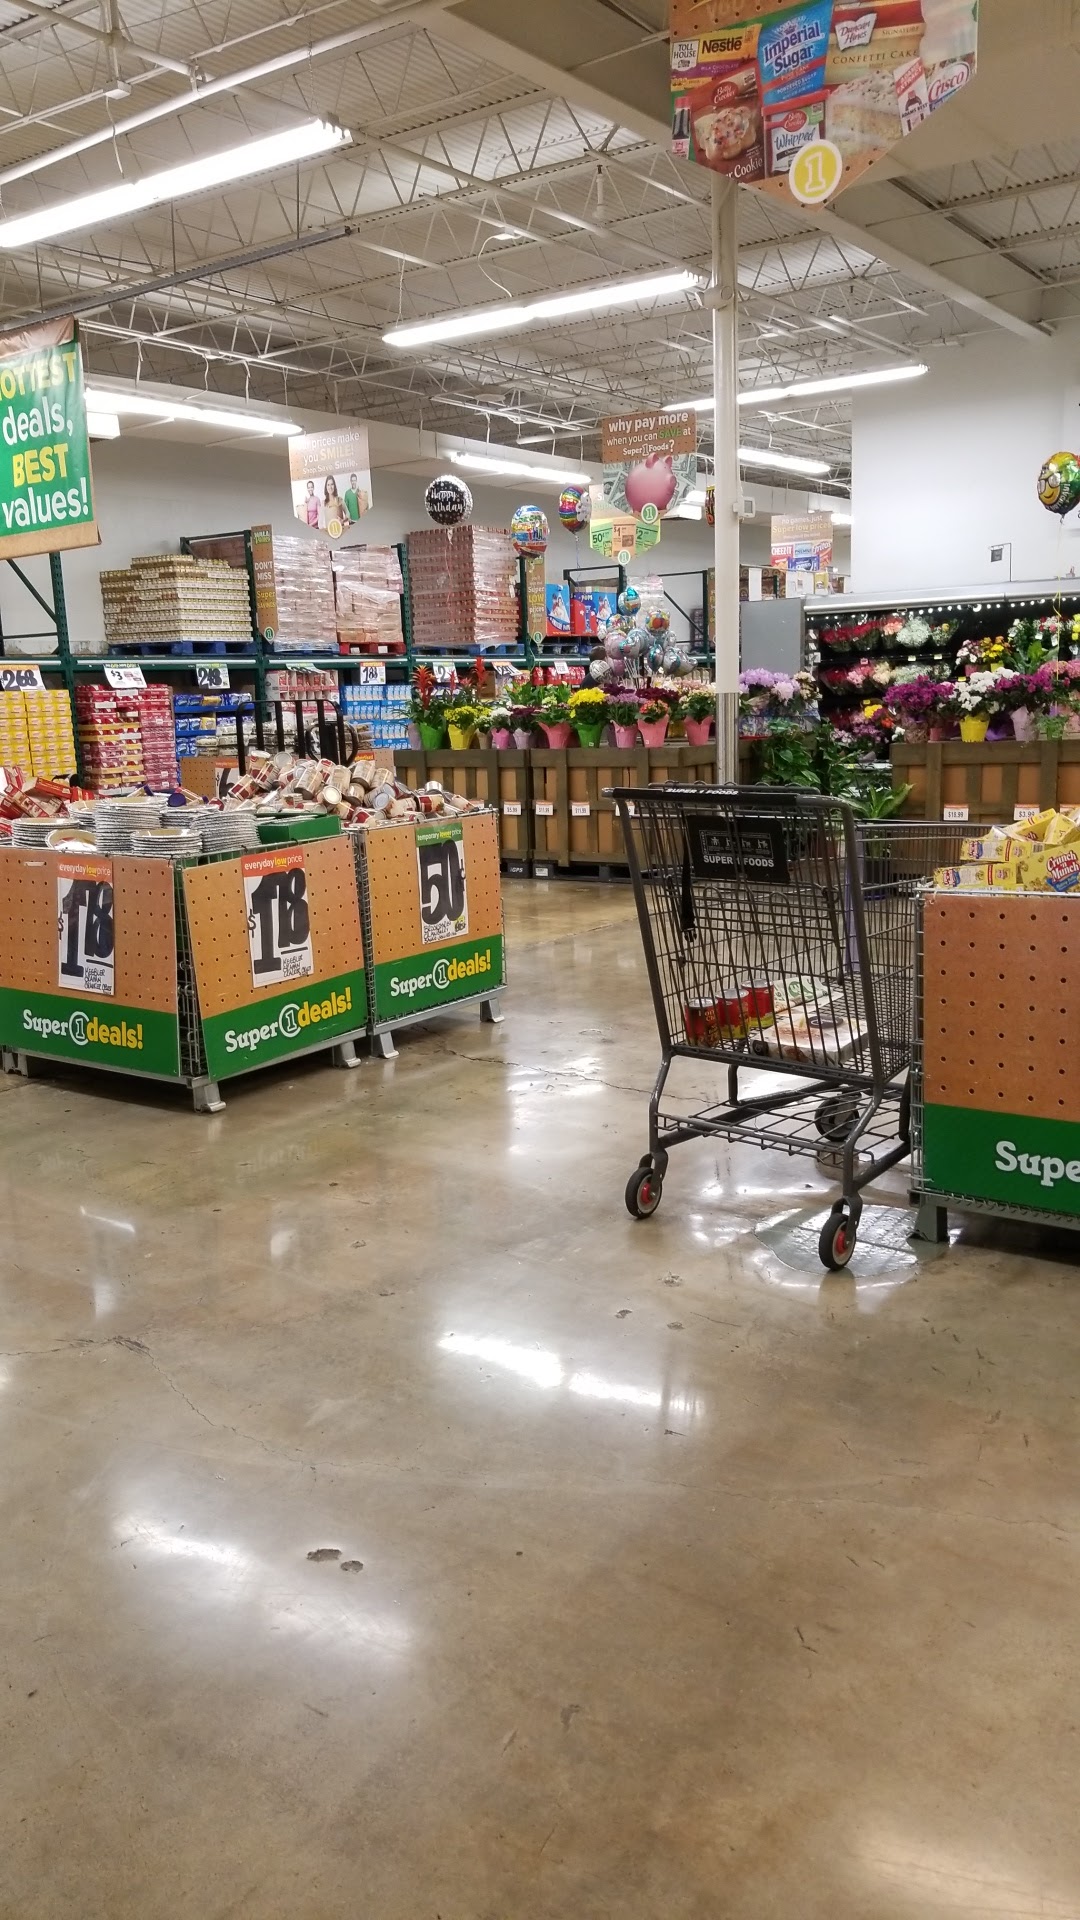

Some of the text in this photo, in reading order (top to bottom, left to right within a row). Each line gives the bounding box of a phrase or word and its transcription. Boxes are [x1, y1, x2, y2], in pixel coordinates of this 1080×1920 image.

[841, 21, 870, 36] Duncan
[763, 21, 821, 65] Imperial
[845, 31, 867, 44] Hines
[673, 50, 696, 59] HOUSE
[678, 43, 694, 51] TOLL
[774, 45, 814, 74] Sugar
[832, 49, 918, 64] CONFETTI CAKE
[774, 128, 815, 150] Whipped
[734, 158, 763, 178] Cookie
[0, 352, 77, 401] OTTEST
[2, 396, 73, 446] deals,
[608, 411, 688, 433] why pay more
[312, 436, 336, 450] prices
[338, 431, 360, 444] make
[607, 427, 691, 447] when you can SAVE at
[622, 446, 643, 456] Super
[12, 443, 69, 488] BEST
[303, 453, 319, 467] you
[431, 488, 456, 501] Happy
[2, 477, 89, 529] values!
[772, 525, 794, 534] Super
[810, 521, 832, 531] prices
[254, 561, 273, 570] DON'T
[257, 572, 272, 581] MISS
[257, 590, 275, 599] Super
[528, 594, 544, 603] LOW
[110, 669, 123, 680] $3
[417, 832, 439, 841] temporary
[452, 829, 461, 837] price
[245, 854, 303, 870] everyday low price
[703, 855, 733, 865] SUPER
[743, 857, 774, 867] FOODS
[1047, 850, 1077, 872] Crunch
[60, 864, 111, 876] everyday low price
[1051, 862, 1080, 882] Munch
[390, 974, 432, 997] Super
[447, 949, 491, 981] deals!
[224, 1020, 278, 1053] Super
[298, 987, 352, 1029] deals!
[22, 1008, 69, 1039] Super
[86, 1016, 144, 1049] deals!
